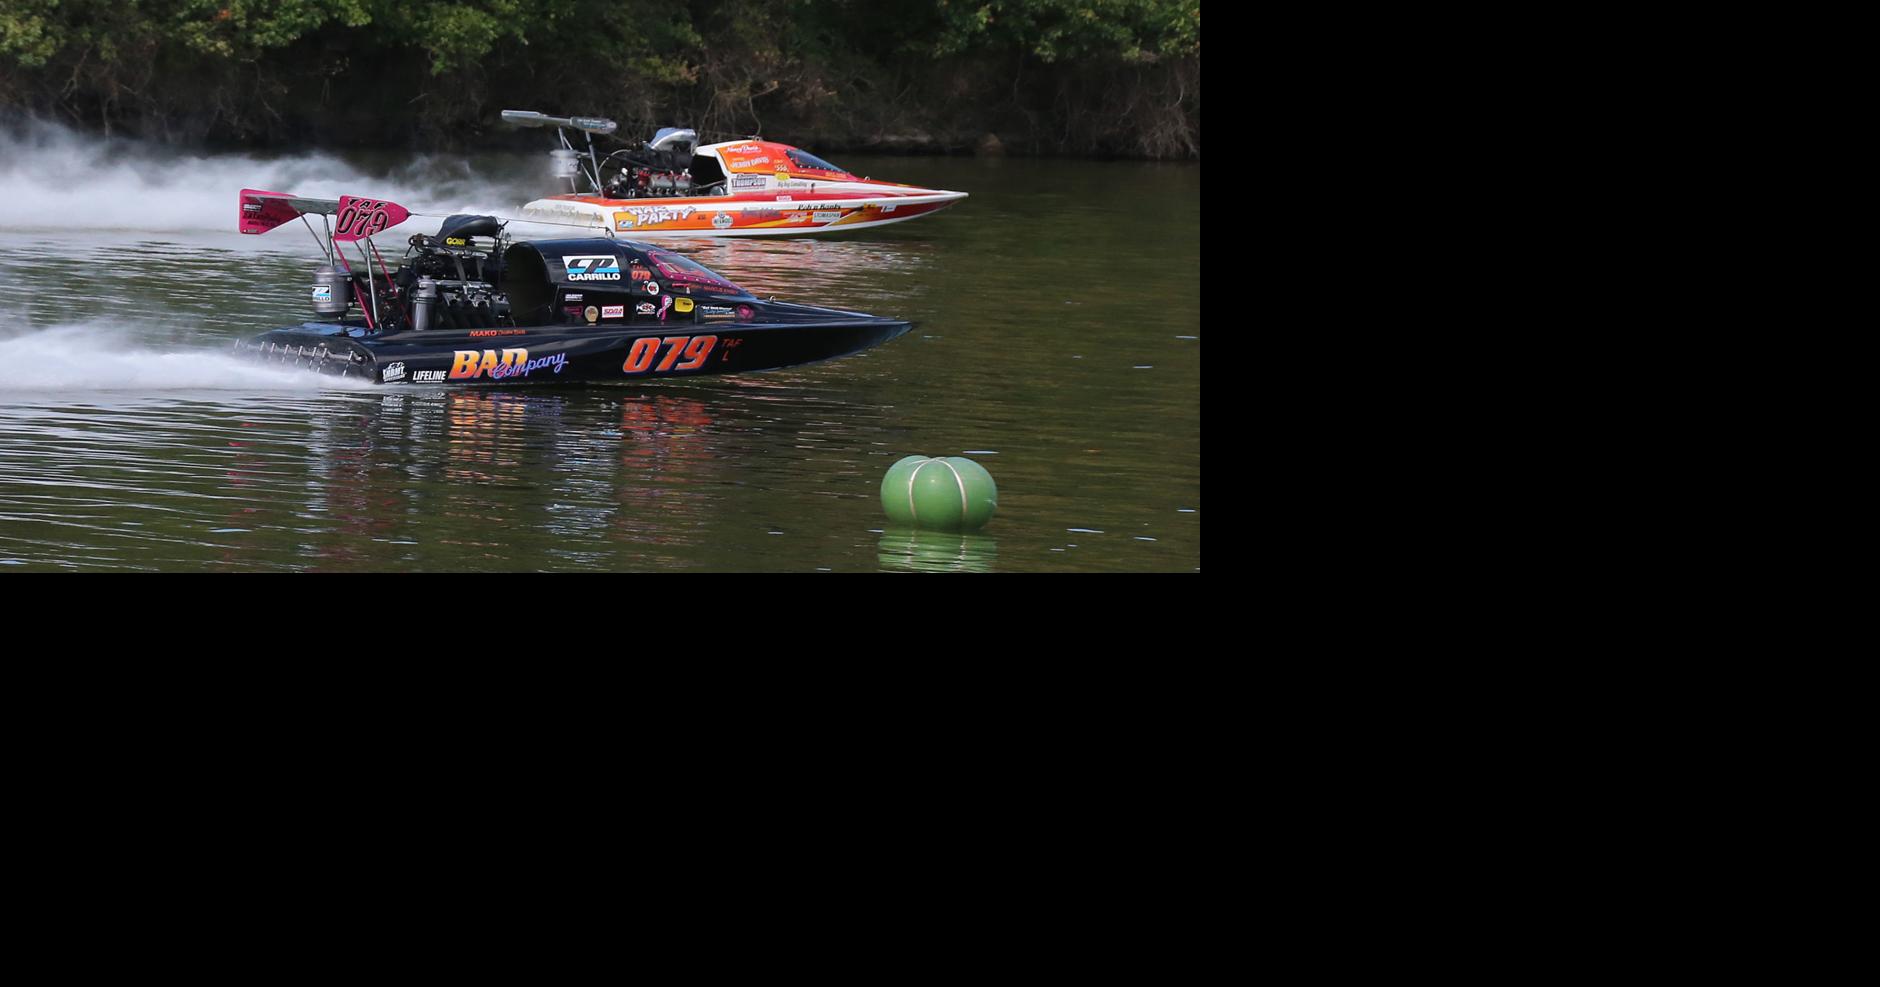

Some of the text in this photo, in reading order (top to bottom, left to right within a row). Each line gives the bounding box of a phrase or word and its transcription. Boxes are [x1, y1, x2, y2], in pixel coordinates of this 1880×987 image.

[349, 199, 386, 209] TAF
[637, 206, 696, 226] PARTY
[337, 207, 389, 237] 079
[567, 273, 621, 281] CARRILLO
[721, 338, 743, 348] TAF
[622, 335, 718, 373] 079
[721, 351, 729, 361] L
[448, 348, 569, 379] BAD Company
[412, 370, 447, 381] LIFELINE
